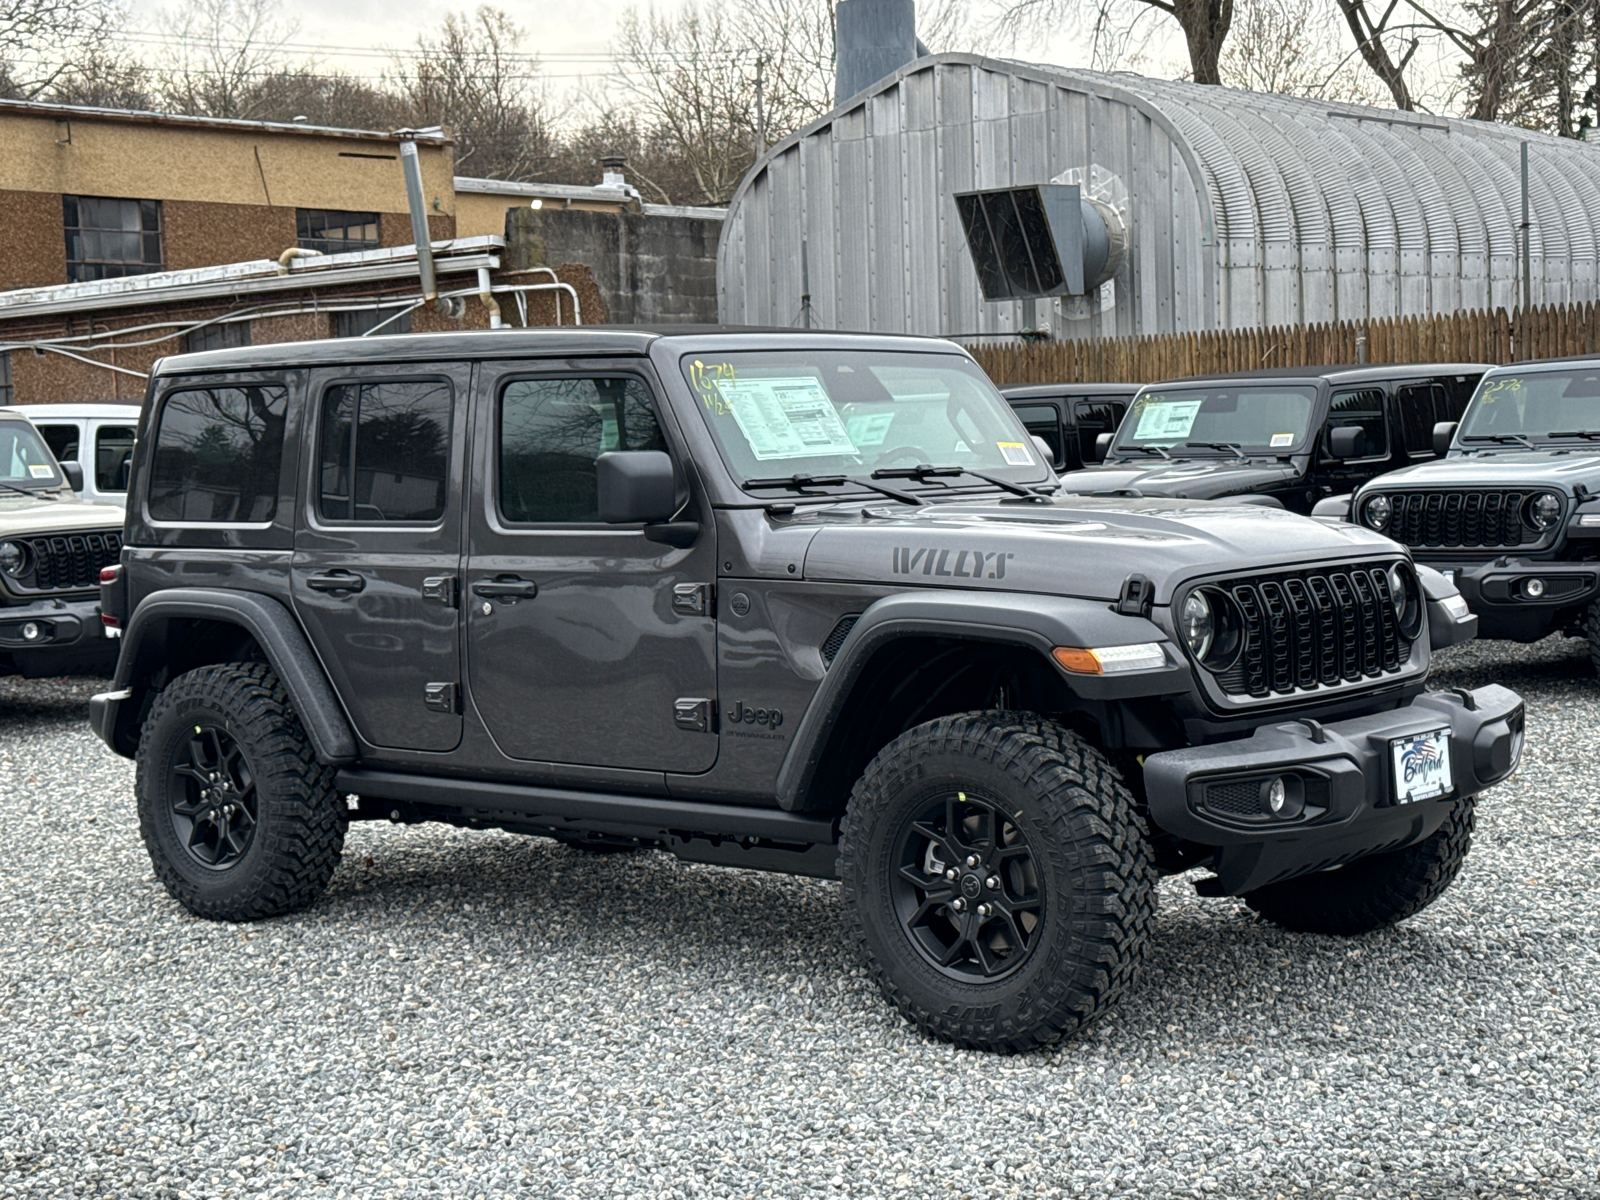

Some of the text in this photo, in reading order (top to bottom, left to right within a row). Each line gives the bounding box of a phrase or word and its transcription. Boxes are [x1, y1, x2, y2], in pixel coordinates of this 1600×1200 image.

[1484, 378, 1524, 395] 2576
[892, 547, 1014, 579] WILLYS
[727, 700, 784, 730] Jeep
[735, 731, 785, 741] WRANGLER
[1401, 750, 1444, 783] Bedford
[942, 1003, 1002, 1022] M/T
